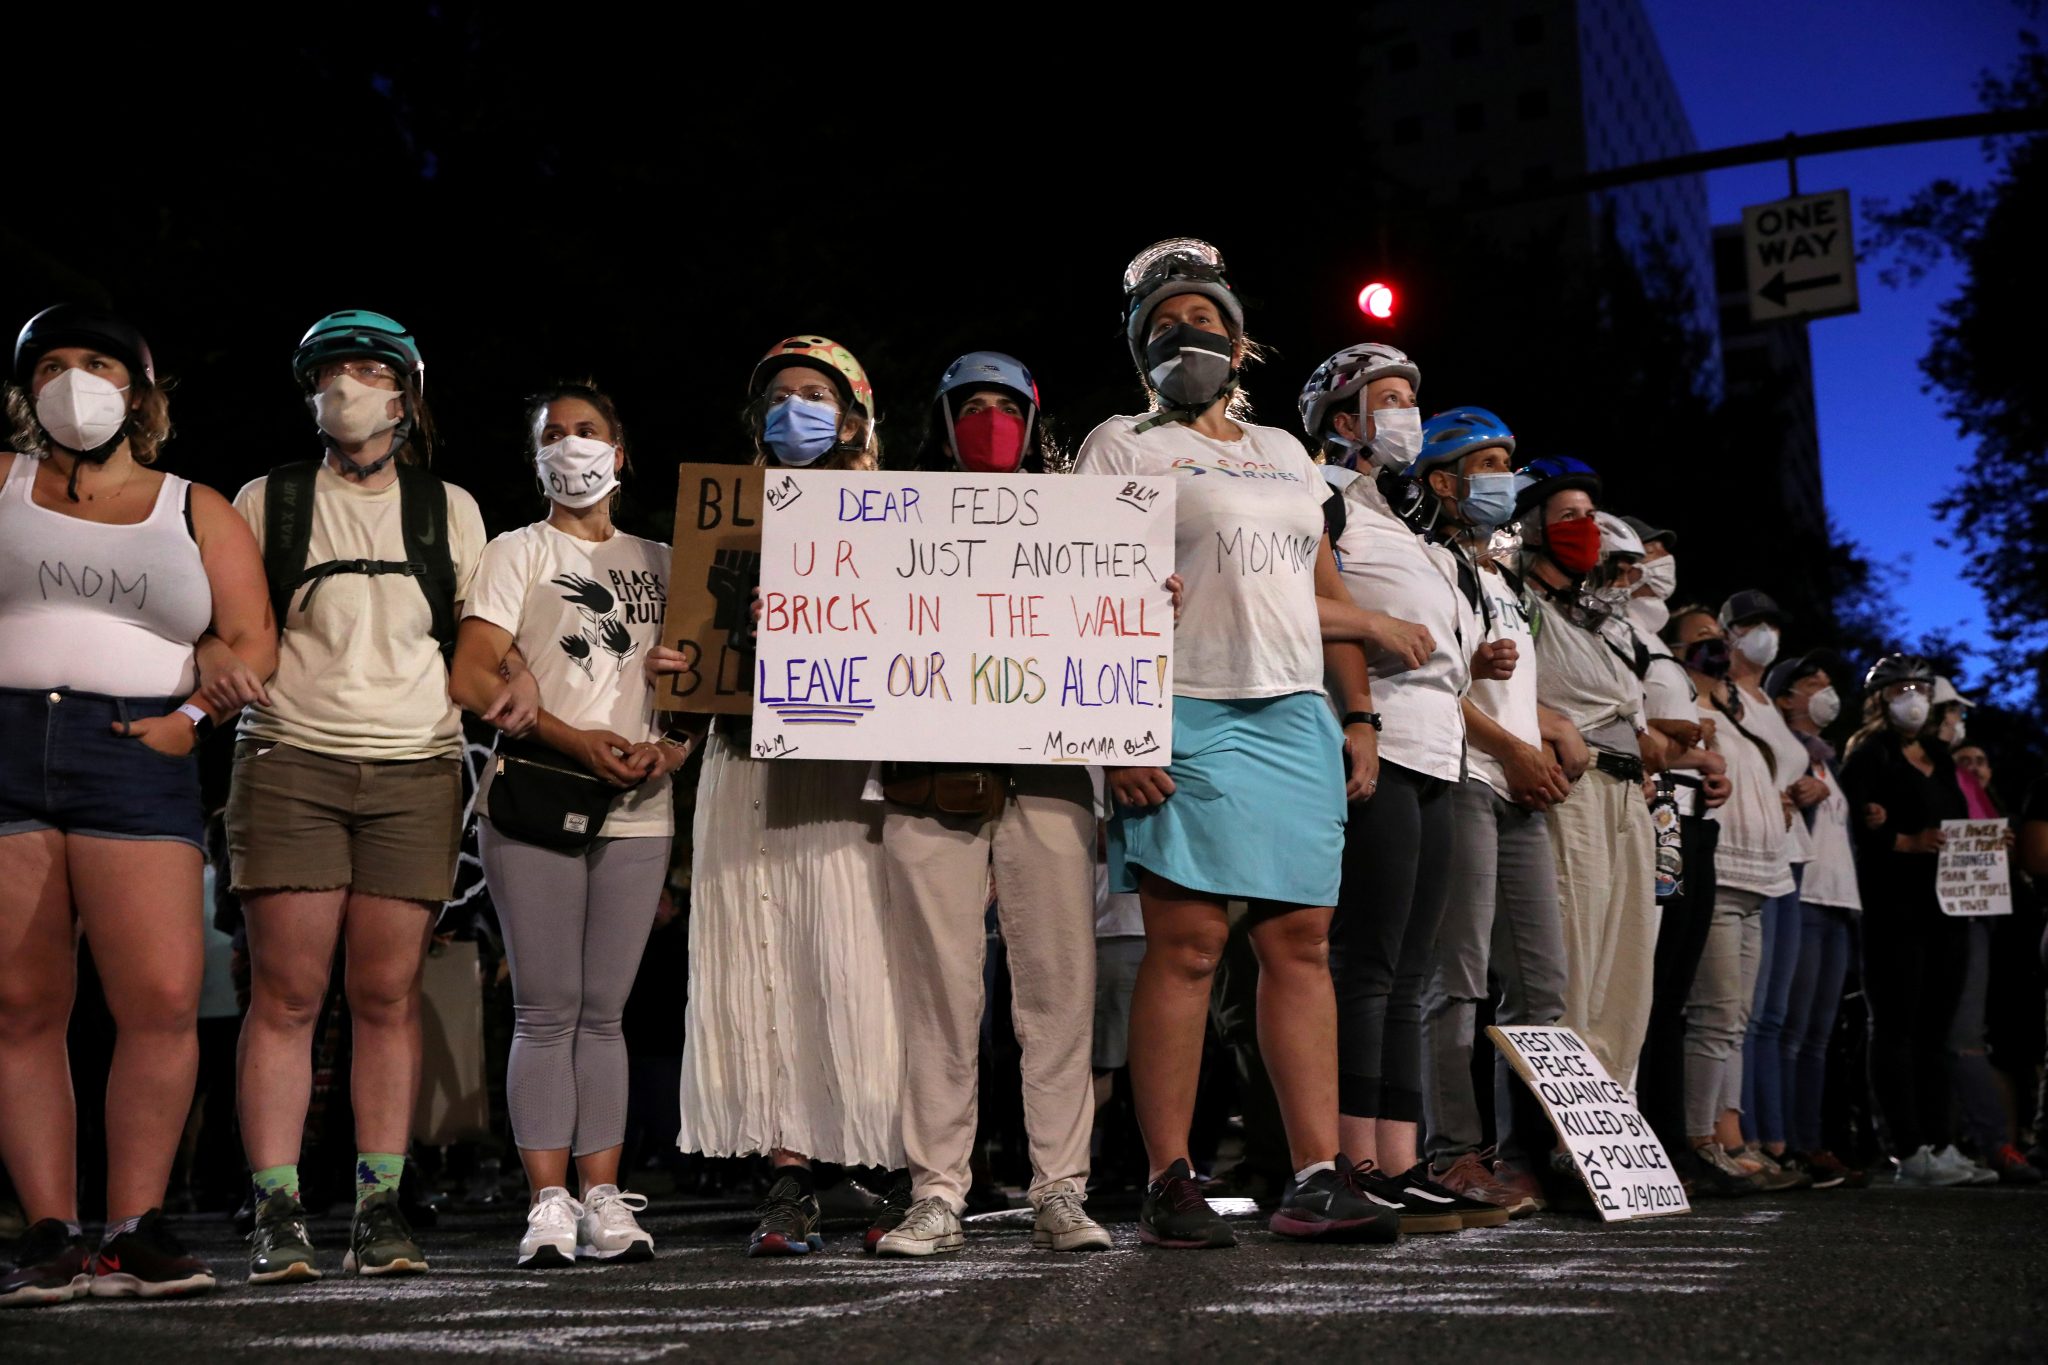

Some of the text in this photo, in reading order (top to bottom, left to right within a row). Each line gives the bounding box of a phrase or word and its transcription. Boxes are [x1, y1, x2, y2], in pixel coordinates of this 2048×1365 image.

[1756, 200, 1836, 236] ONE
[1757, 229, 1838, 267] WAY
[549, 469, 602, 496] BLM
[767, 475, 802, 506] BLM
[1119, 481, 1159, 508] BLM
[698, 477, 755, 530] BL
[839, 487, 1039, 526] DEAR FEDS
[794, 538, 1157, 582] U R JUST ANOTHER
[39, 560, 147, 610] MOM
[608, 569, 665, 589] BLACK
[615, 585, 667, 602] LIVES
[767, 592, 1160, 637] BRICK IN THE WALL
[760, 651, 1167, 708] LEAVE OUR KIDS ALONE!
[755, 734, 788, 757] BLM
[1124, 730, 1157, 755] BLM
[1508, 1032, 1585, 1053] REST IN
[1528, 1055, 1594, 1078] PEACE
[1540, 1080, 1629, 1109] QUANICE
[1557, 1110, 1649, 1137] KILLED BY
[1600, 1144, 1667, 1170] POLICE
[1621, 1183, 1686, 1211] 2/9/2017
